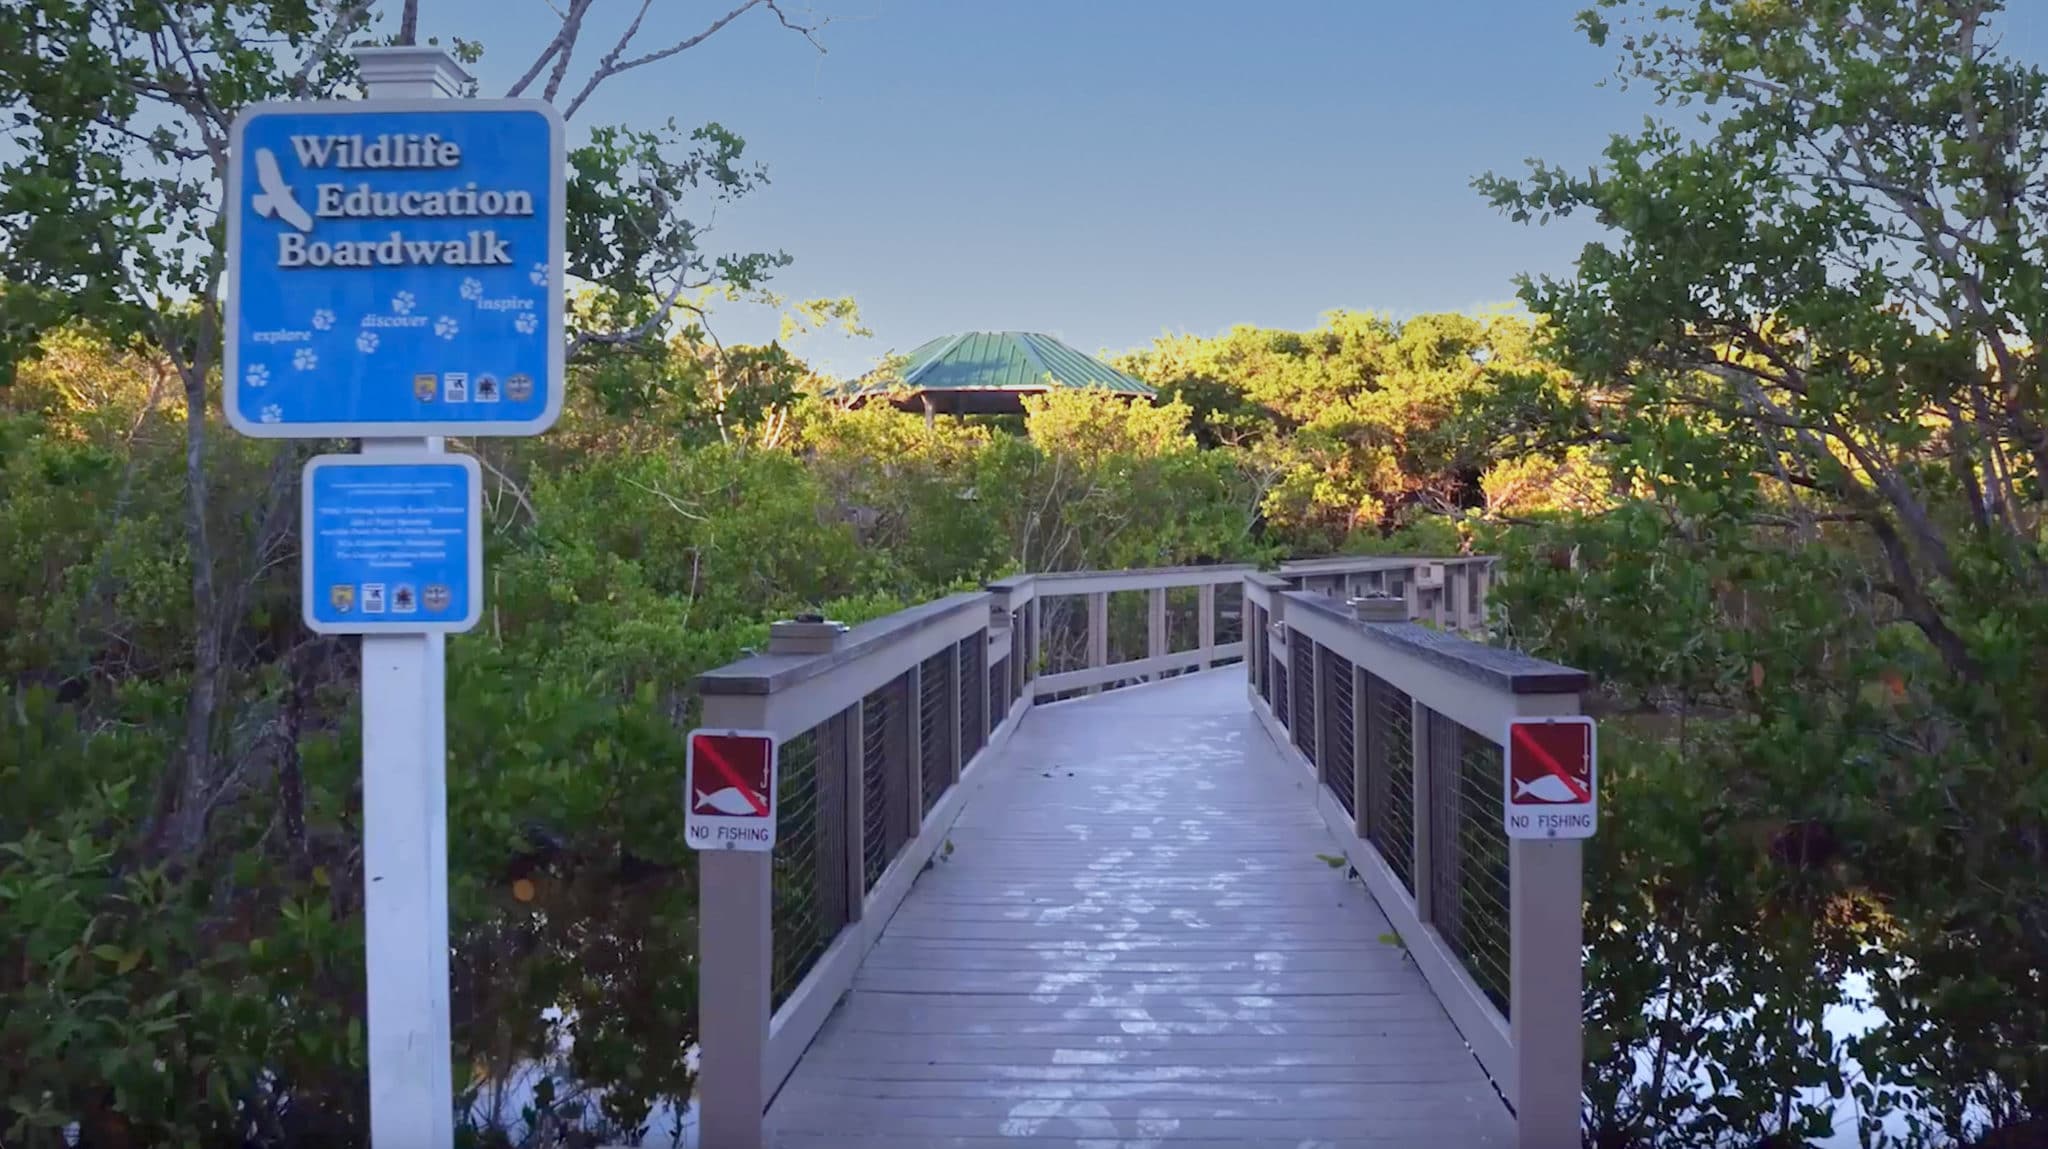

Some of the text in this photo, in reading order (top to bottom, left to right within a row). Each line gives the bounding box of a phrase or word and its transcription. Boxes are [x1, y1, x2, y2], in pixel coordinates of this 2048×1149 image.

[290, 134, 460, 168] Wildlife
[315, 182, 534, 217] Education
[277, 231, 513, 267] Boardwalk
[477, 296, 534, 312] inspire
[361, 313, 429, 328] discover
[253, 328, 313, 344] explore
[1510, 814, 1590, 829] NO FISHING
[690, 825, 769, 841] NO FISHING
